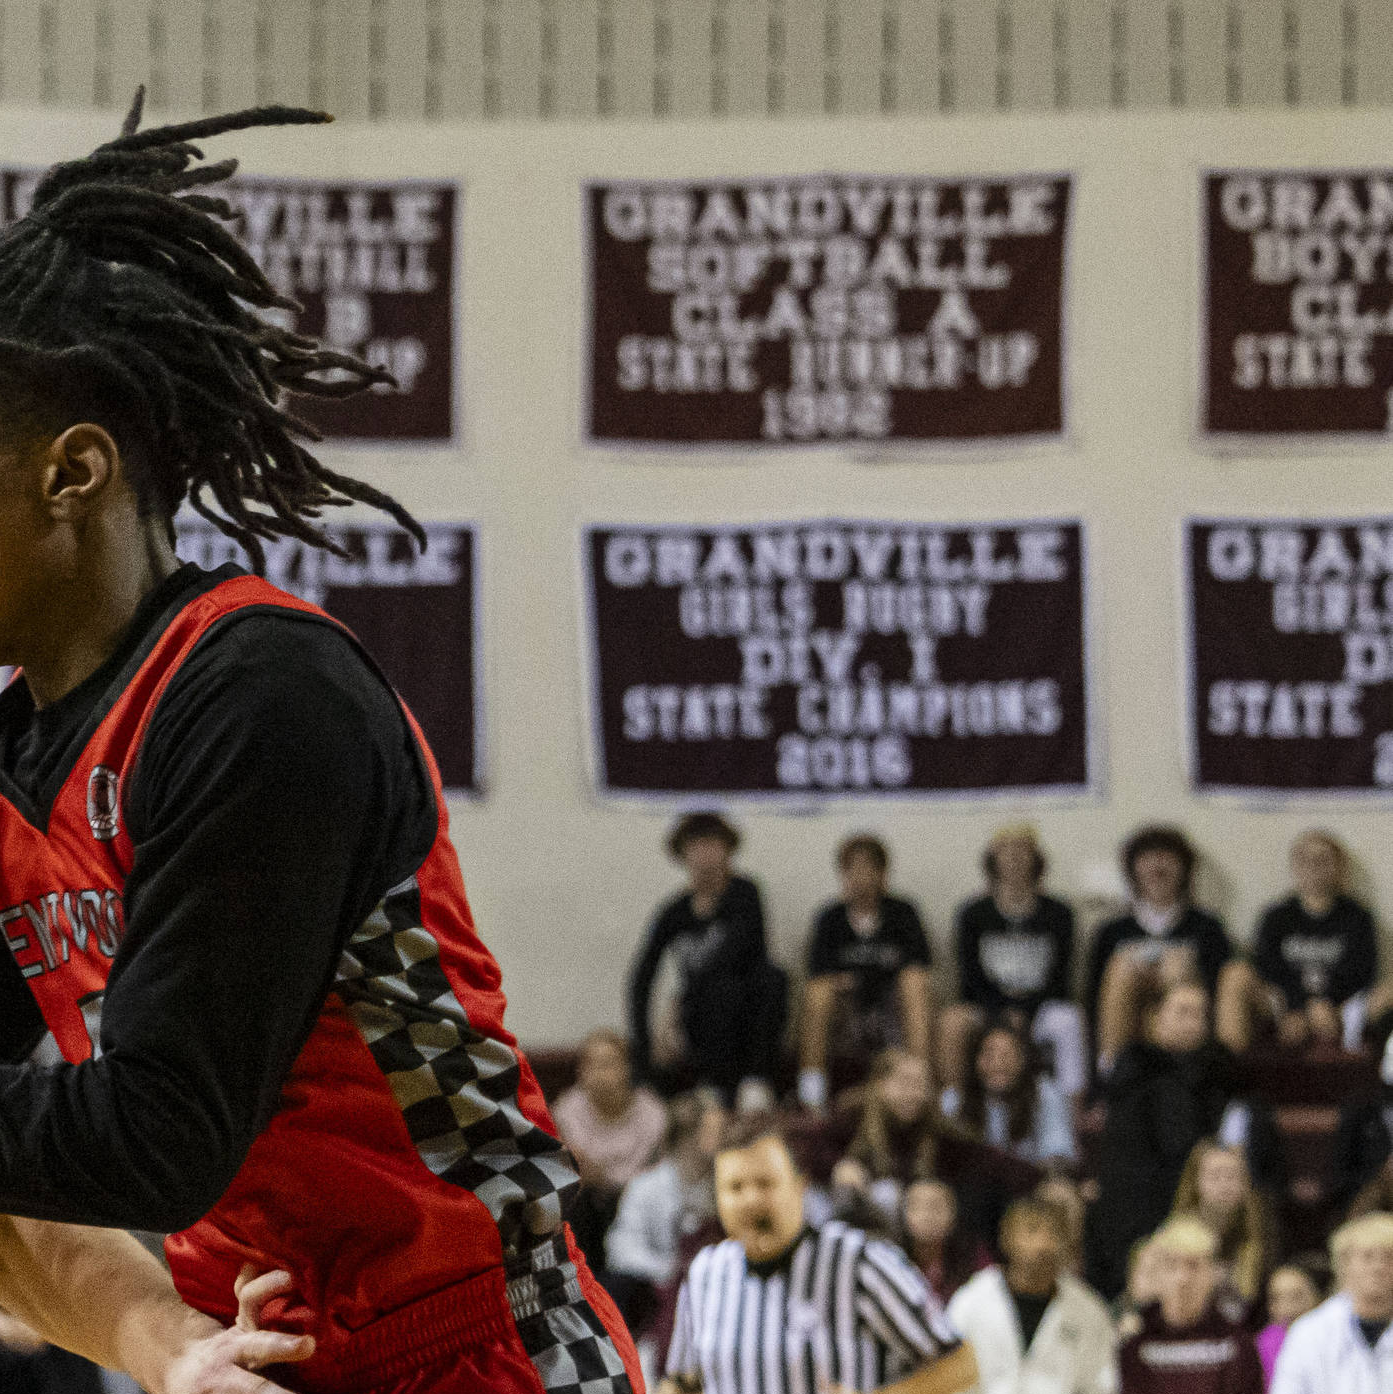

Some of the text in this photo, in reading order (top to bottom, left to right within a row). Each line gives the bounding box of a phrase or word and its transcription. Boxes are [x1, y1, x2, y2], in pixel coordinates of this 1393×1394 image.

[603, 183, 1055, 243] GRANDVILLE
[646, 234, 1013, 293] SOFTBALL
[670, 286, 981, 342] CLASS A
[615, 333, 760, 392] STATE
[1231, 331, 1374, 391] STATE
[603, 529, 1068, 588] GRANDVILLE
[740, 628, 883, 687] DIV.
[621, 677, 1065, 742] STATE CHAMPIONS
[1207, 678, 1364, 740] STATE
